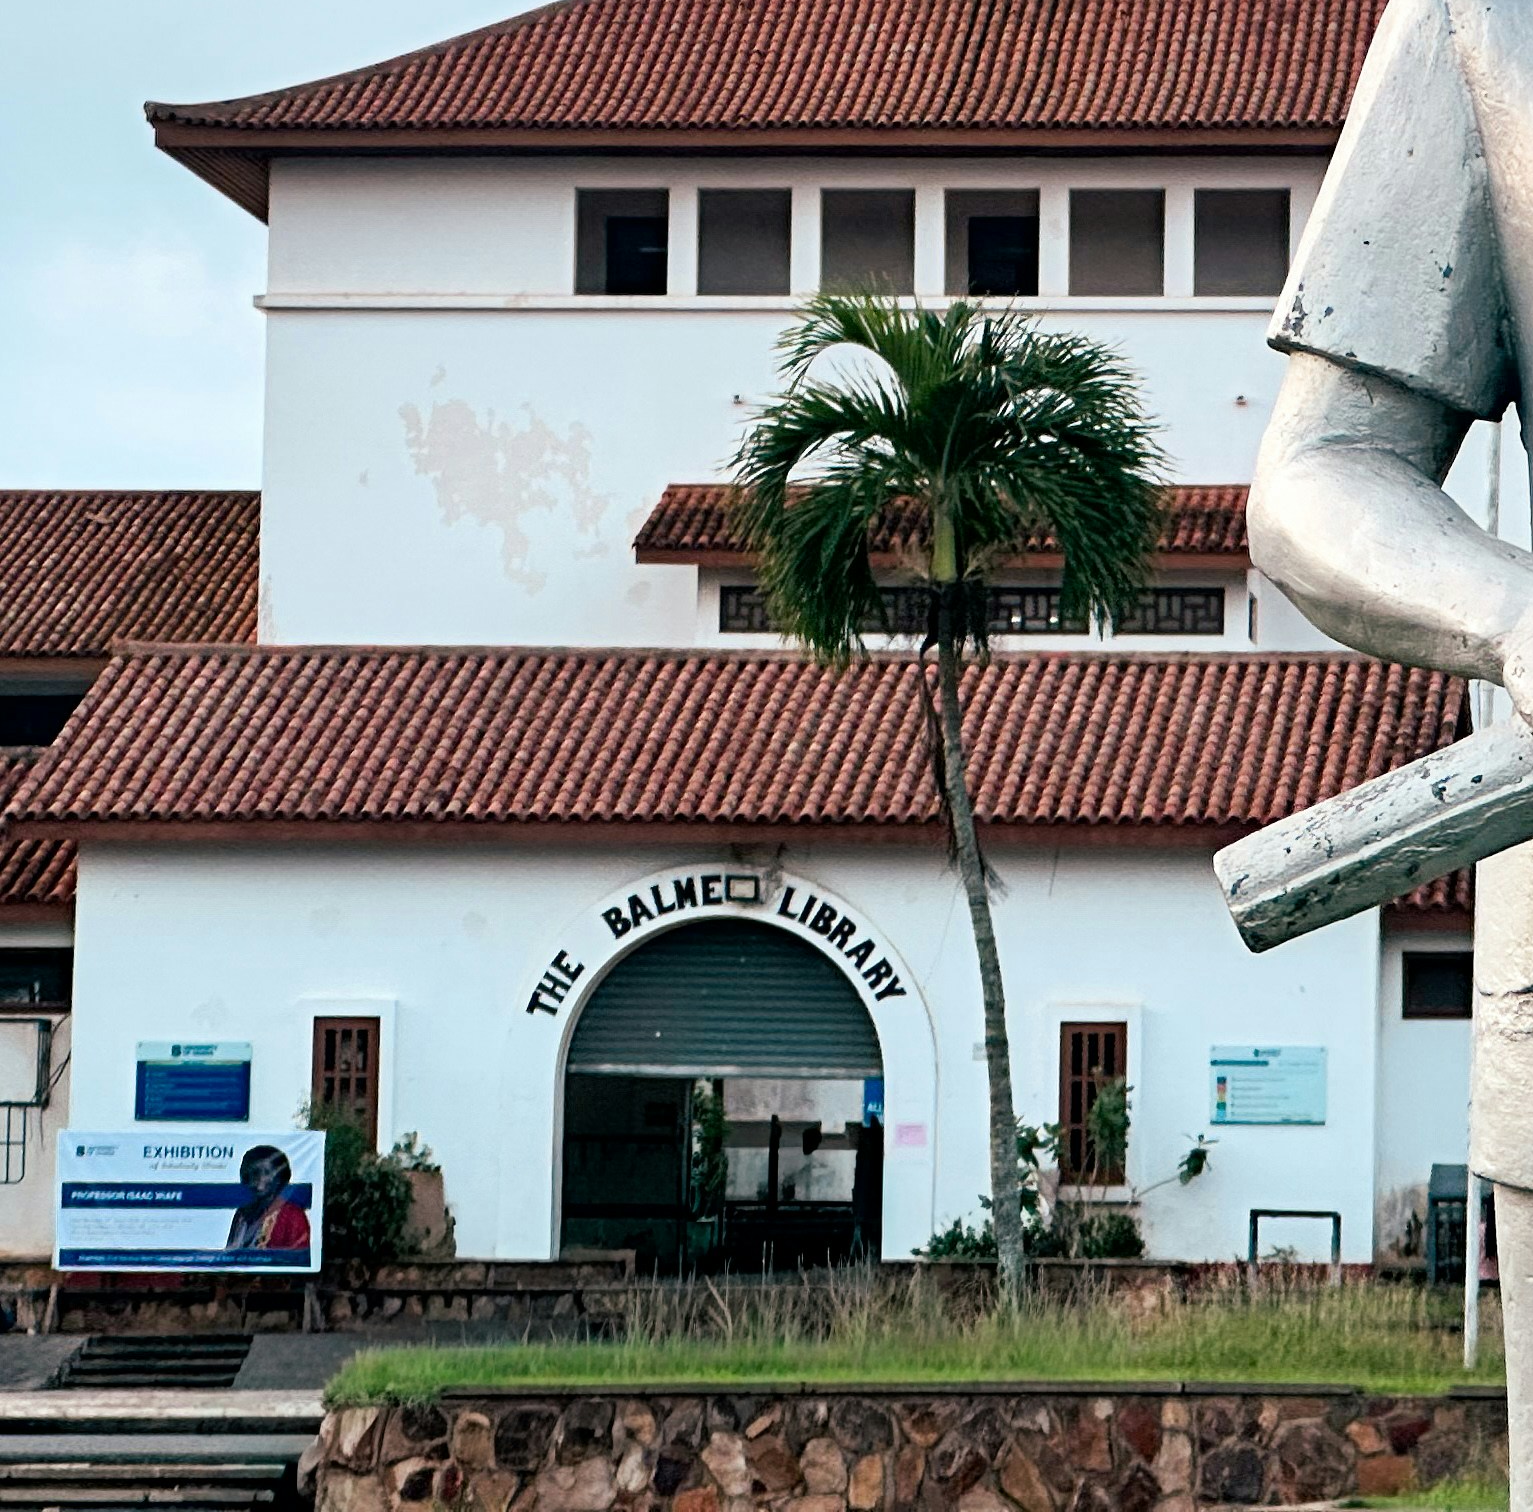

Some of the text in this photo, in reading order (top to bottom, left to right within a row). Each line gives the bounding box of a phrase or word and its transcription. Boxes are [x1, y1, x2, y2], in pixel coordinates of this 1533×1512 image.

[526, 874, 907, 1016] THE BALME LIBRARY
[143, 1145, 234, 1159] EXHIBITION
[71, 1191, 125, 1201] PROFESSOR
[126, 1191, 153, 1201] ISAAC
